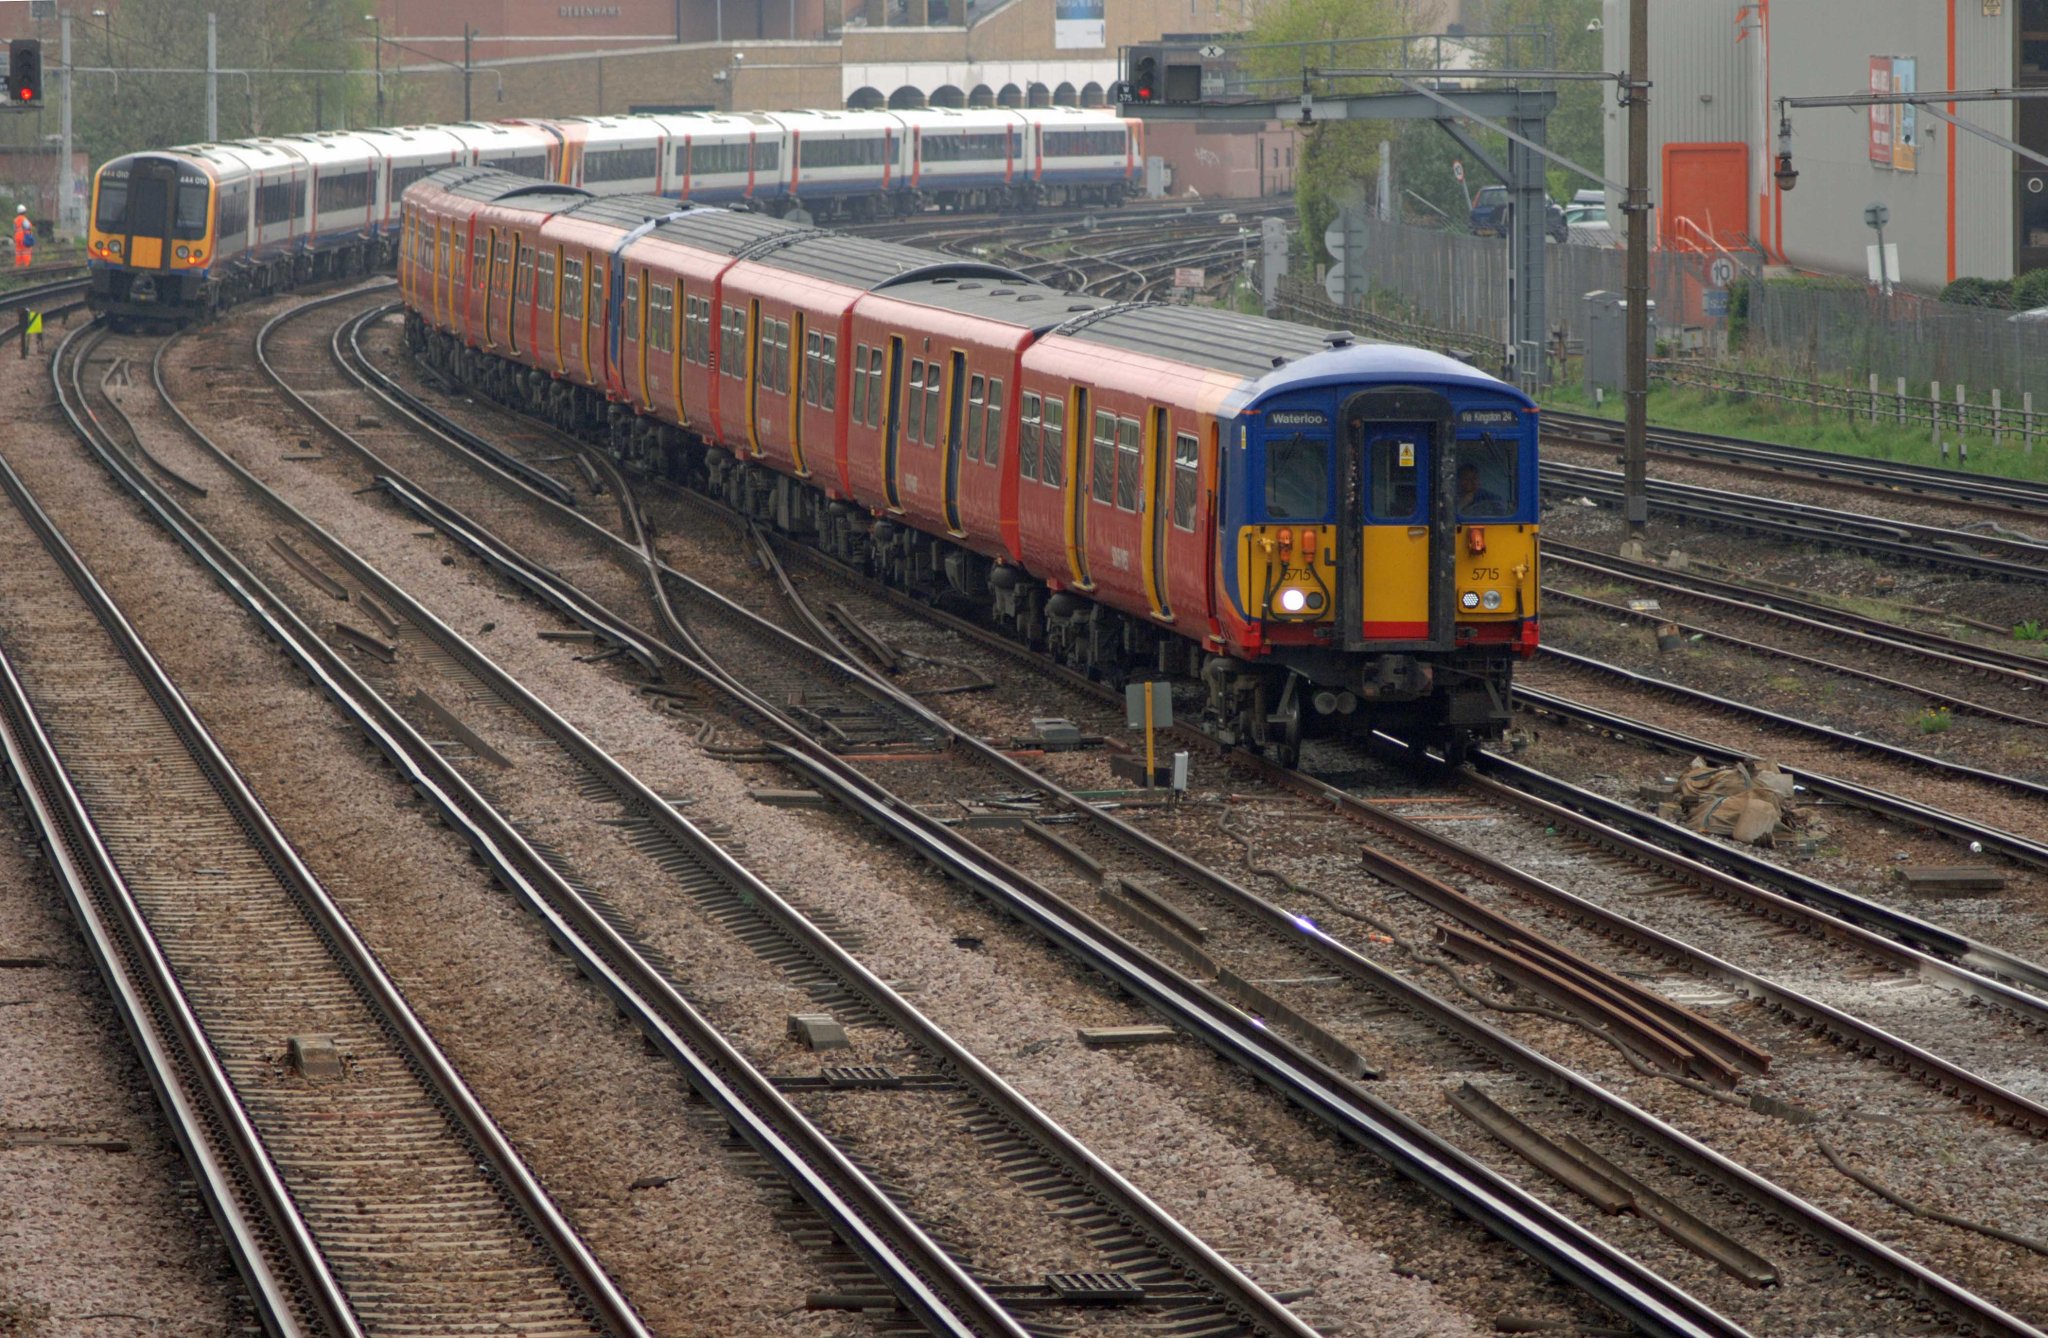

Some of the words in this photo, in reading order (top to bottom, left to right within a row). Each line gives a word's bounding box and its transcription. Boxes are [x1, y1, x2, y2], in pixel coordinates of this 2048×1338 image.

[559, 6, 621, 17] DEBENHAMS
[1207, 46, 1216, 57] X
[1713, 264, 1730, 281] 10
[1272, 413, 1322, 424] Waterloo
[1474, 412, 1501, 424] Kingston
[1283, 568, 1311, 581] 5715
[1471, 568, 1499, 581] 5715
